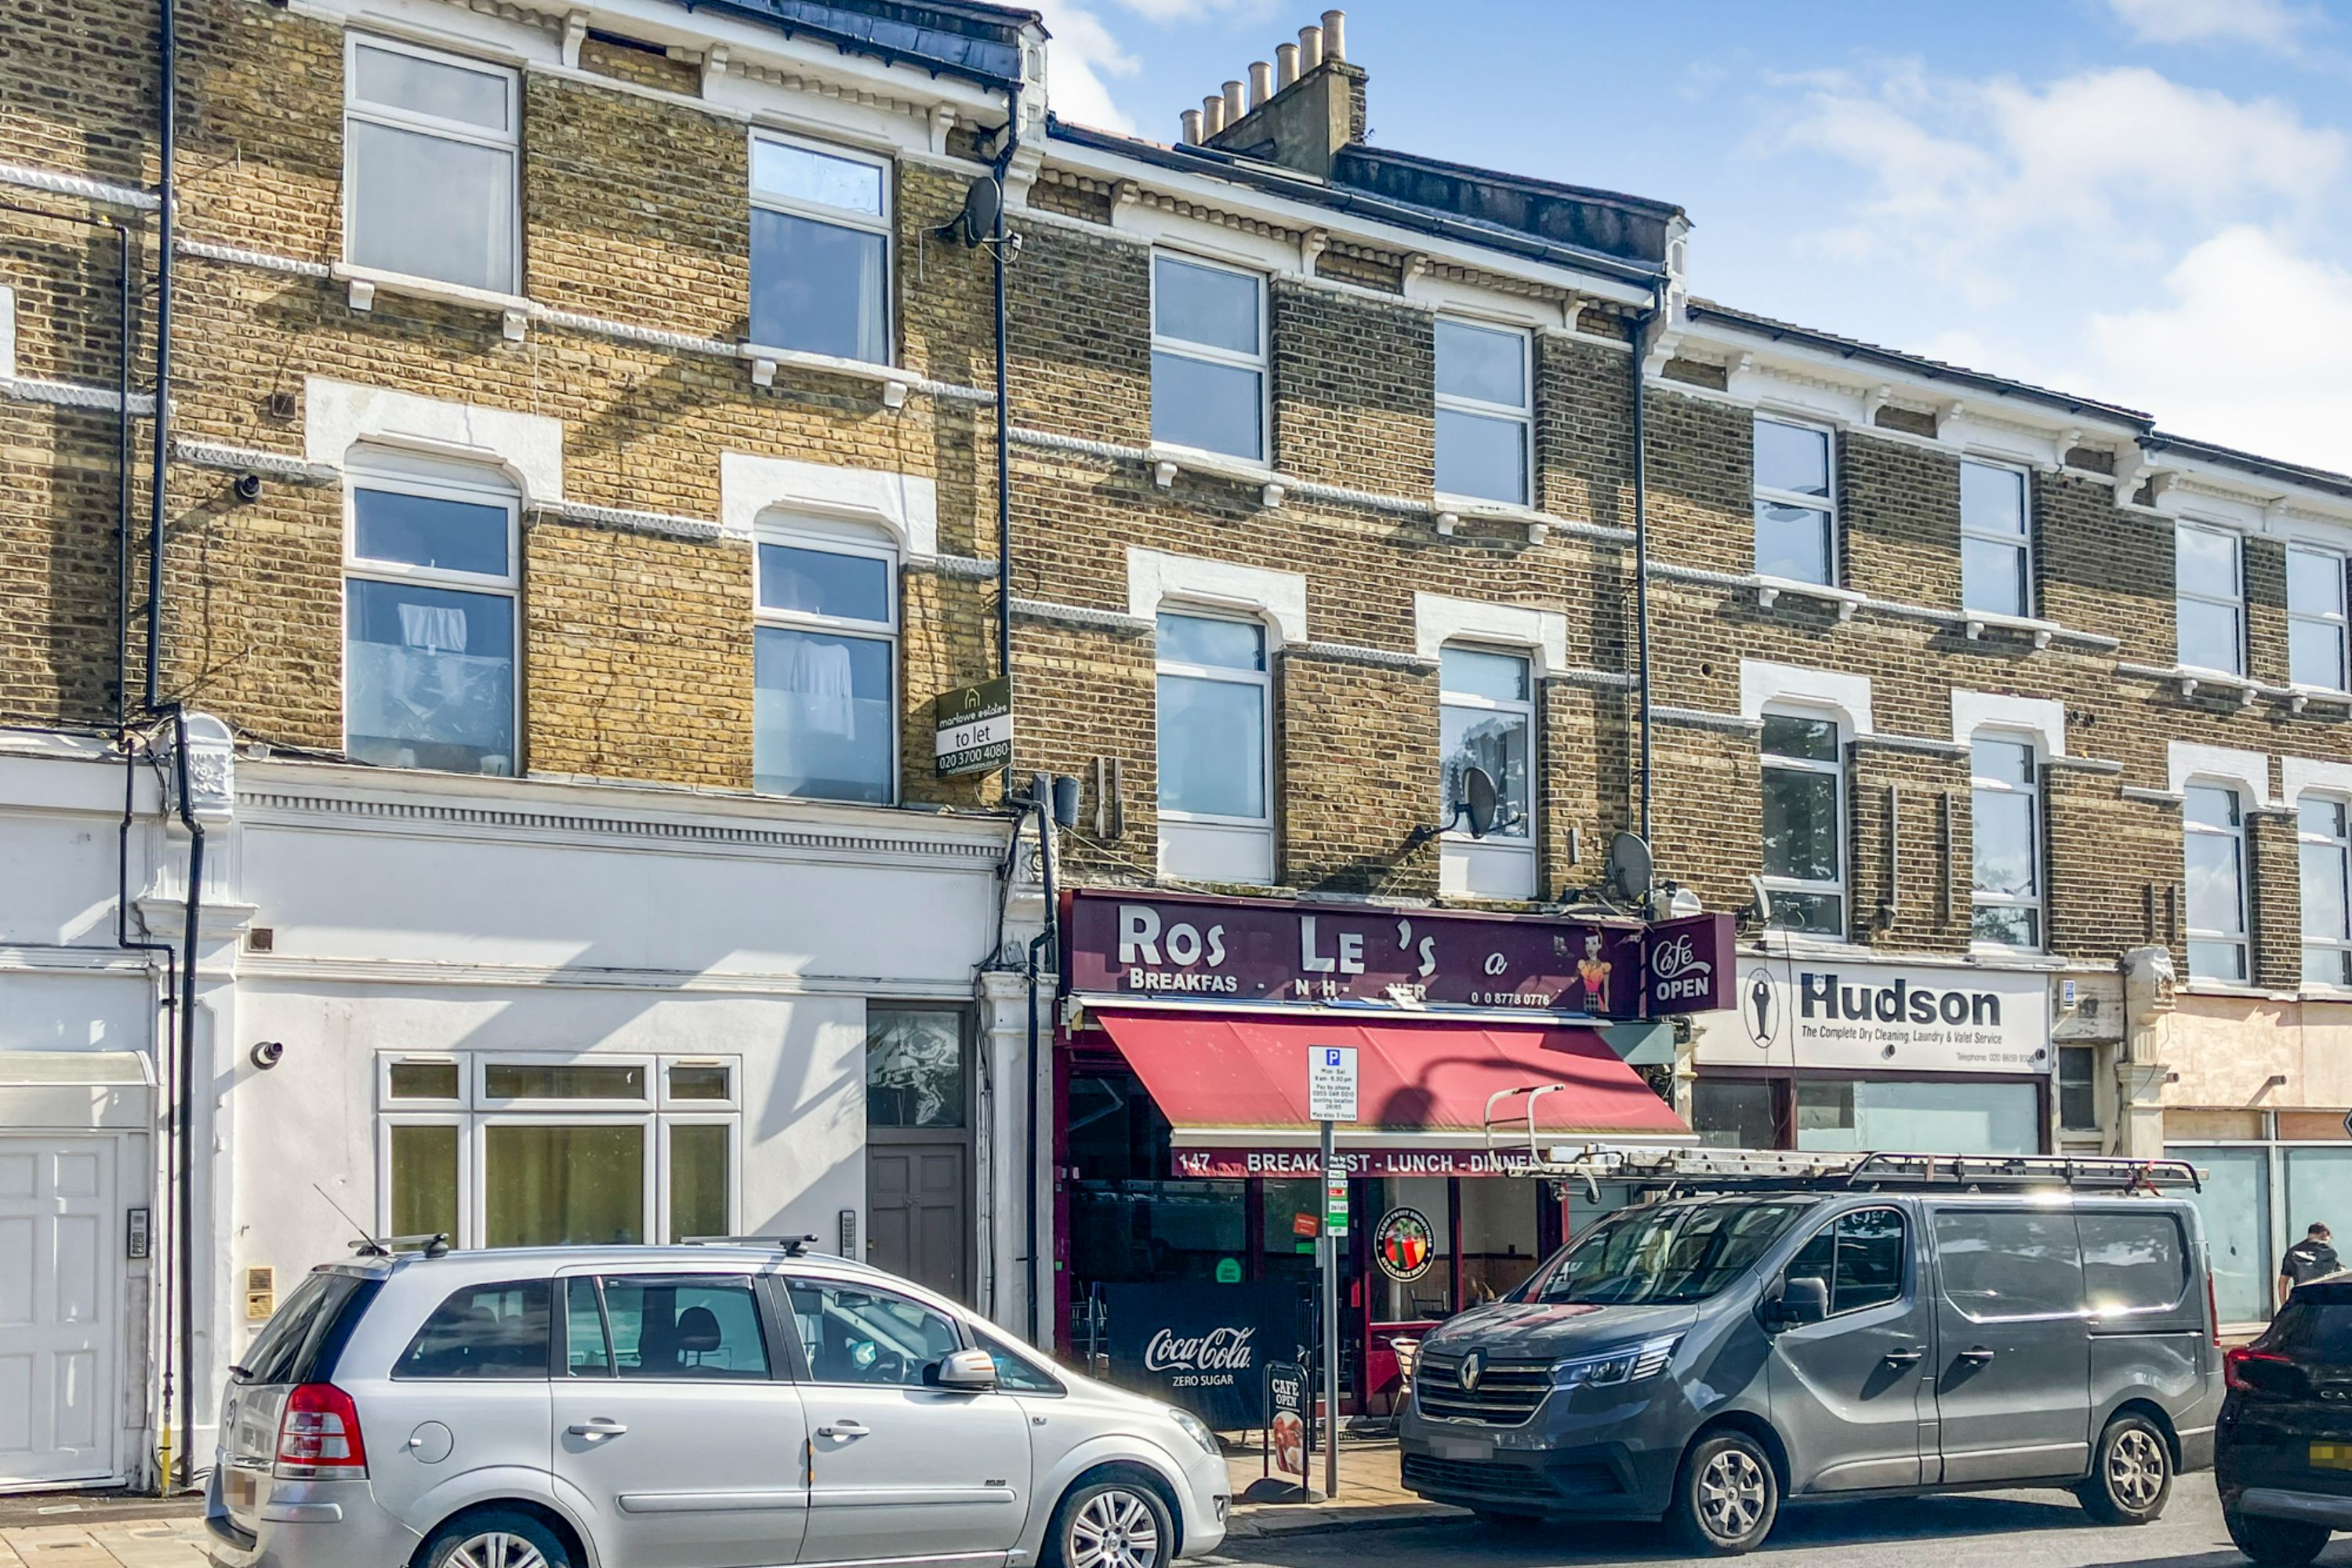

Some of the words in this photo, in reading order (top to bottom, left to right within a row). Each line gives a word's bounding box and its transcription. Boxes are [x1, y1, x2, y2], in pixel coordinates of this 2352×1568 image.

[978, 702, 1007, 718] estates
[956, 732, 969, 747] to
[973, 725, 990, 743] let
[939, 754, 956, 769] 020
[958, 749, 982, 765] 3700
[1656, 977, 1708, 1000] OPEN
[1494, 993, 1521, 1004] 8778
[1524, 994, 1549, 1005] 0776
[1801, 972, 2001, 1026] Hudson
[1802, 1025, 1817, 1037] The
[1820, 1025, 1857, 1040] Complete
[1859, 1028, 1872, 1042] Dry
[1913, 1030, 1944, 1044] Laundry
[1946, 1031, 1951, 1043] &
[1955, 1032, 1973, 1043] Valet
[1974, 1033, 2002, 1044] Service
[1328, 1051, 1338, 1065] P
[1179, 1152, 1210, 1171] 147
[1247, 1154, 1370, 1172] BREAKST
[1387, 1154, 1454, 1172] LUNCH
[1145, 1327, 1256, 1372] Coca-Cola
[1173, 1376, 1200, 1387] ZERO
[1201, 1374, 1234, 1386] SUGAR
[1276, 1394, 1297, 1407] OPEN
[2321, 1390, 2352, 1399] CA
